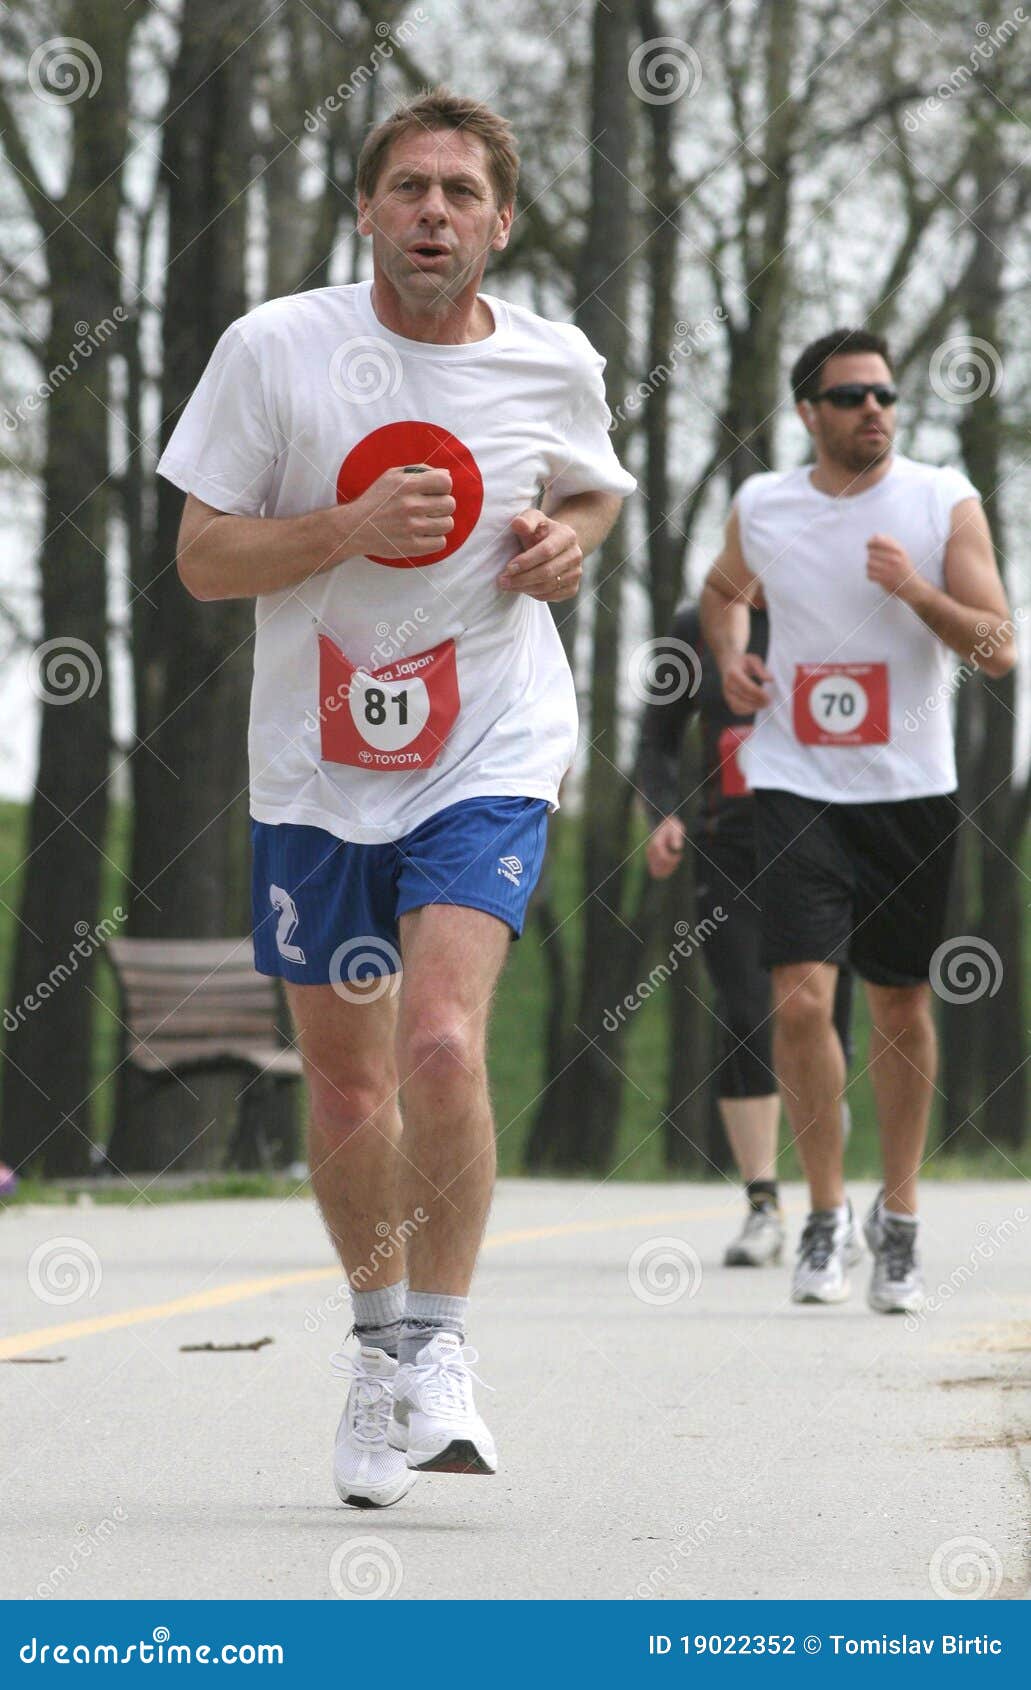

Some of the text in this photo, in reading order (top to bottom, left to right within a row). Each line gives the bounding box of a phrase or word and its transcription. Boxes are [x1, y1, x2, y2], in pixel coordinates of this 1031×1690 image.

[396, 655, 434, 677] Japan
[364, 688, 409, 726] 81
[821, 692, 856, 718] 70
[374, 752, 422, 765] TOYOTA
[269, 883, 306, 965] 2
